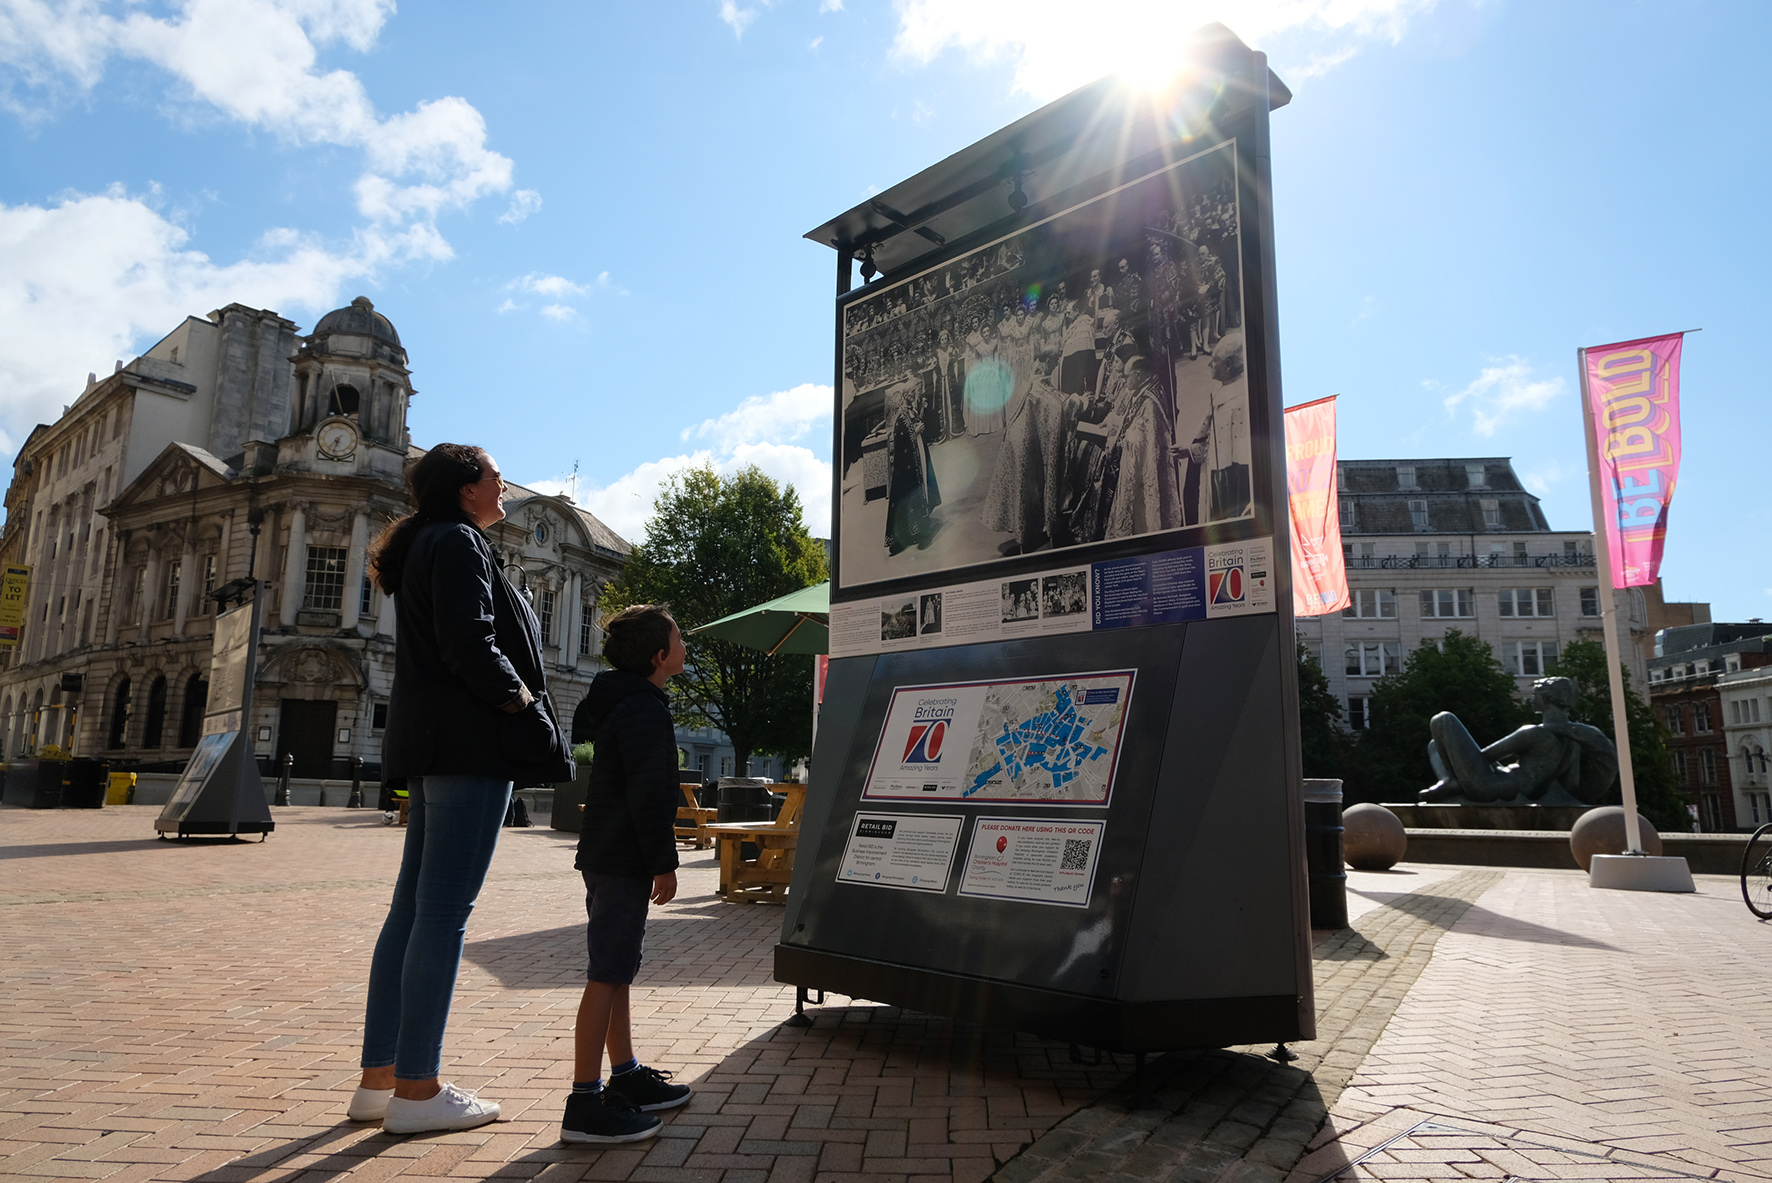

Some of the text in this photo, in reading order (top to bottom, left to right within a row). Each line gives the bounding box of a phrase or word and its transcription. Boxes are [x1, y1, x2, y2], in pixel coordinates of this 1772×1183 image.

[1287, 436, 1335, 460] PROUD
[1597, 349, 1665, 535] BE BOLD
[1208, 549, 1243, 558] Celebrating
[1209, 555, 1244, 568] Britain
[1209, 566, 1245, 604] 70
[1306, 594, 1319, 606] BE
[918, 698, 957, 706] Celebrating
[914, 706, 954, 718] Britain
[901, 719, 951, 763] 70
[899, 764, 923, 772] Amazing
[1077, 827, 1095, 835] CODE
[1053, 883, 1085, 892] Thank you
